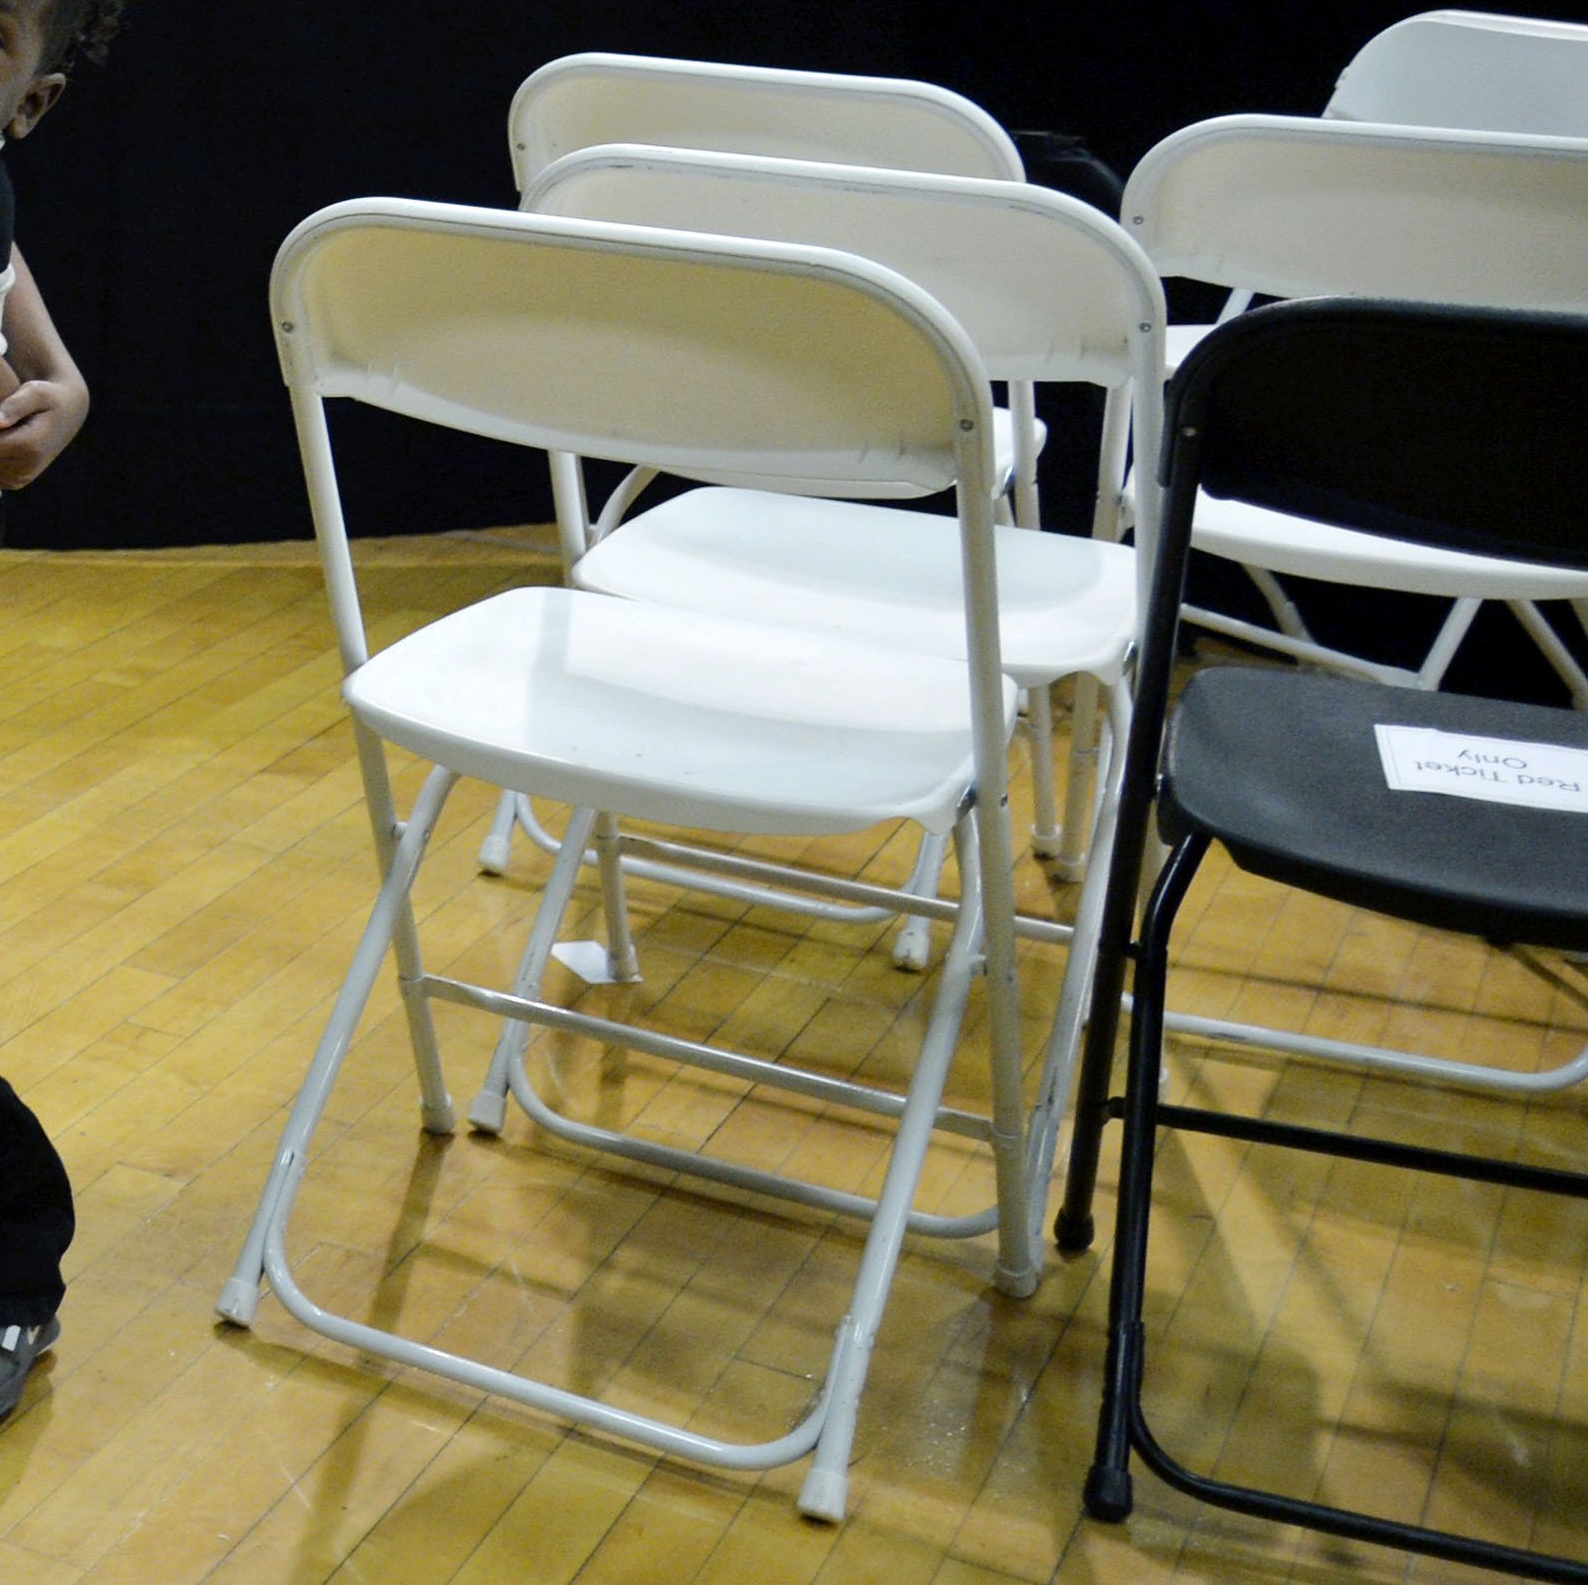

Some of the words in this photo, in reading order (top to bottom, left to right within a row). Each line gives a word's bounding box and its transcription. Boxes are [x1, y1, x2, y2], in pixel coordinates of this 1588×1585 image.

[1458, 749, 1528, 770] Only
[1414, 760, 1506, 783] Ticket
[1516, 774, 1581, 792] Red
